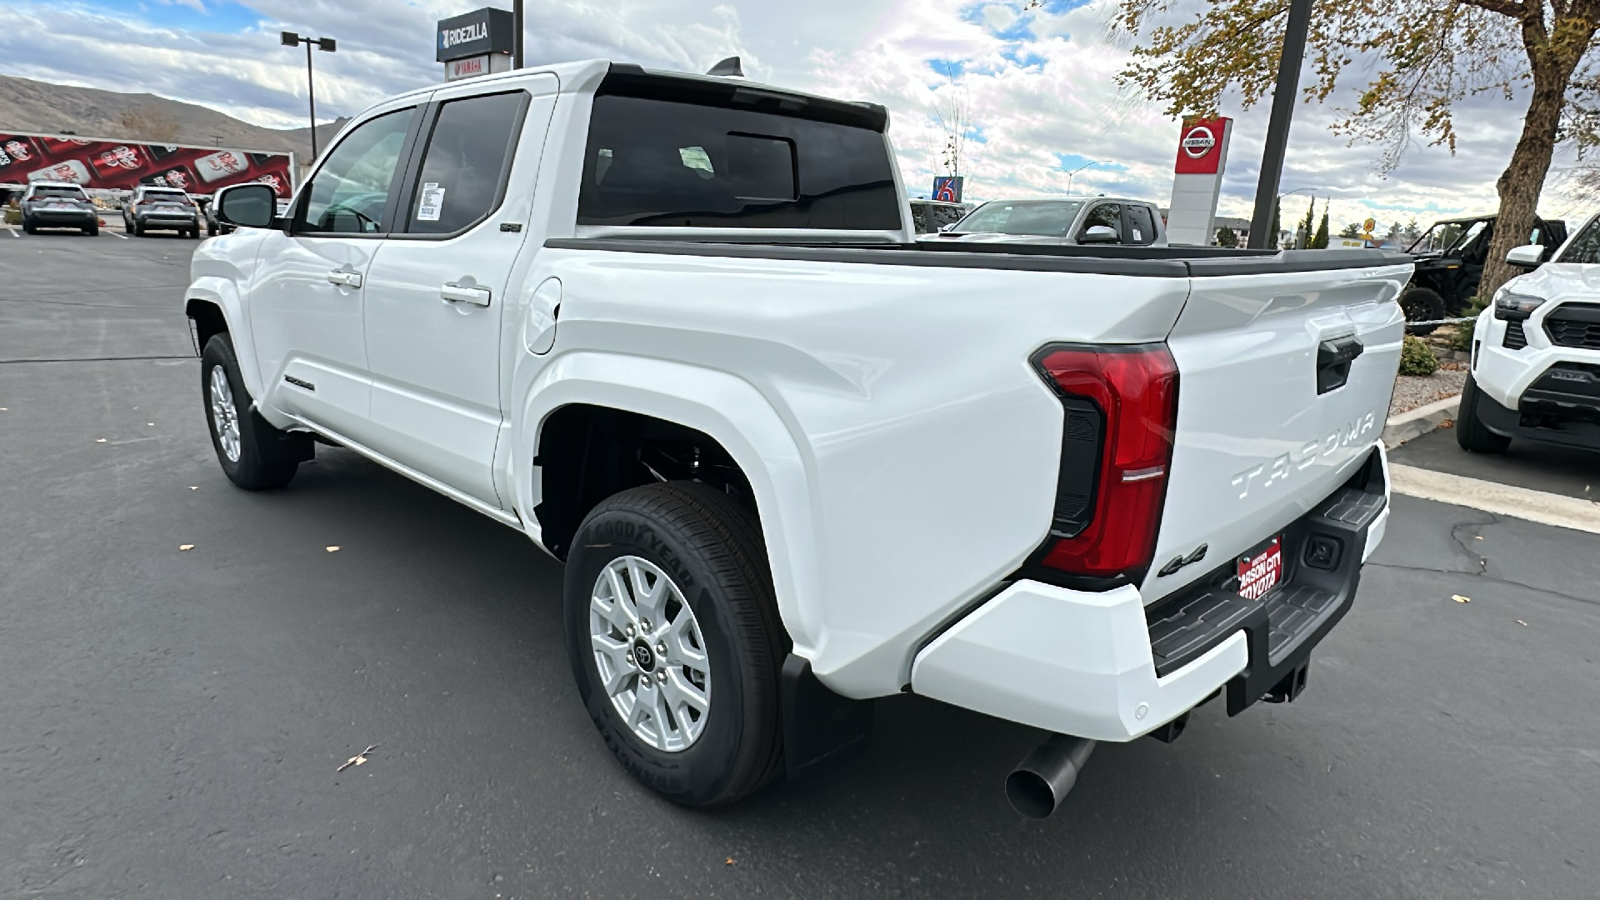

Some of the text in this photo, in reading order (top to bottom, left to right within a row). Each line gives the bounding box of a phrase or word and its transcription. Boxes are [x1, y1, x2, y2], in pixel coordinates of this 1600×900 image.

[449, 22, 488, 46] RIDEZILLA
[1232, 410, 1374, 499] TACOMA
[1238, 550, 1281, 590] ARSON CITY
